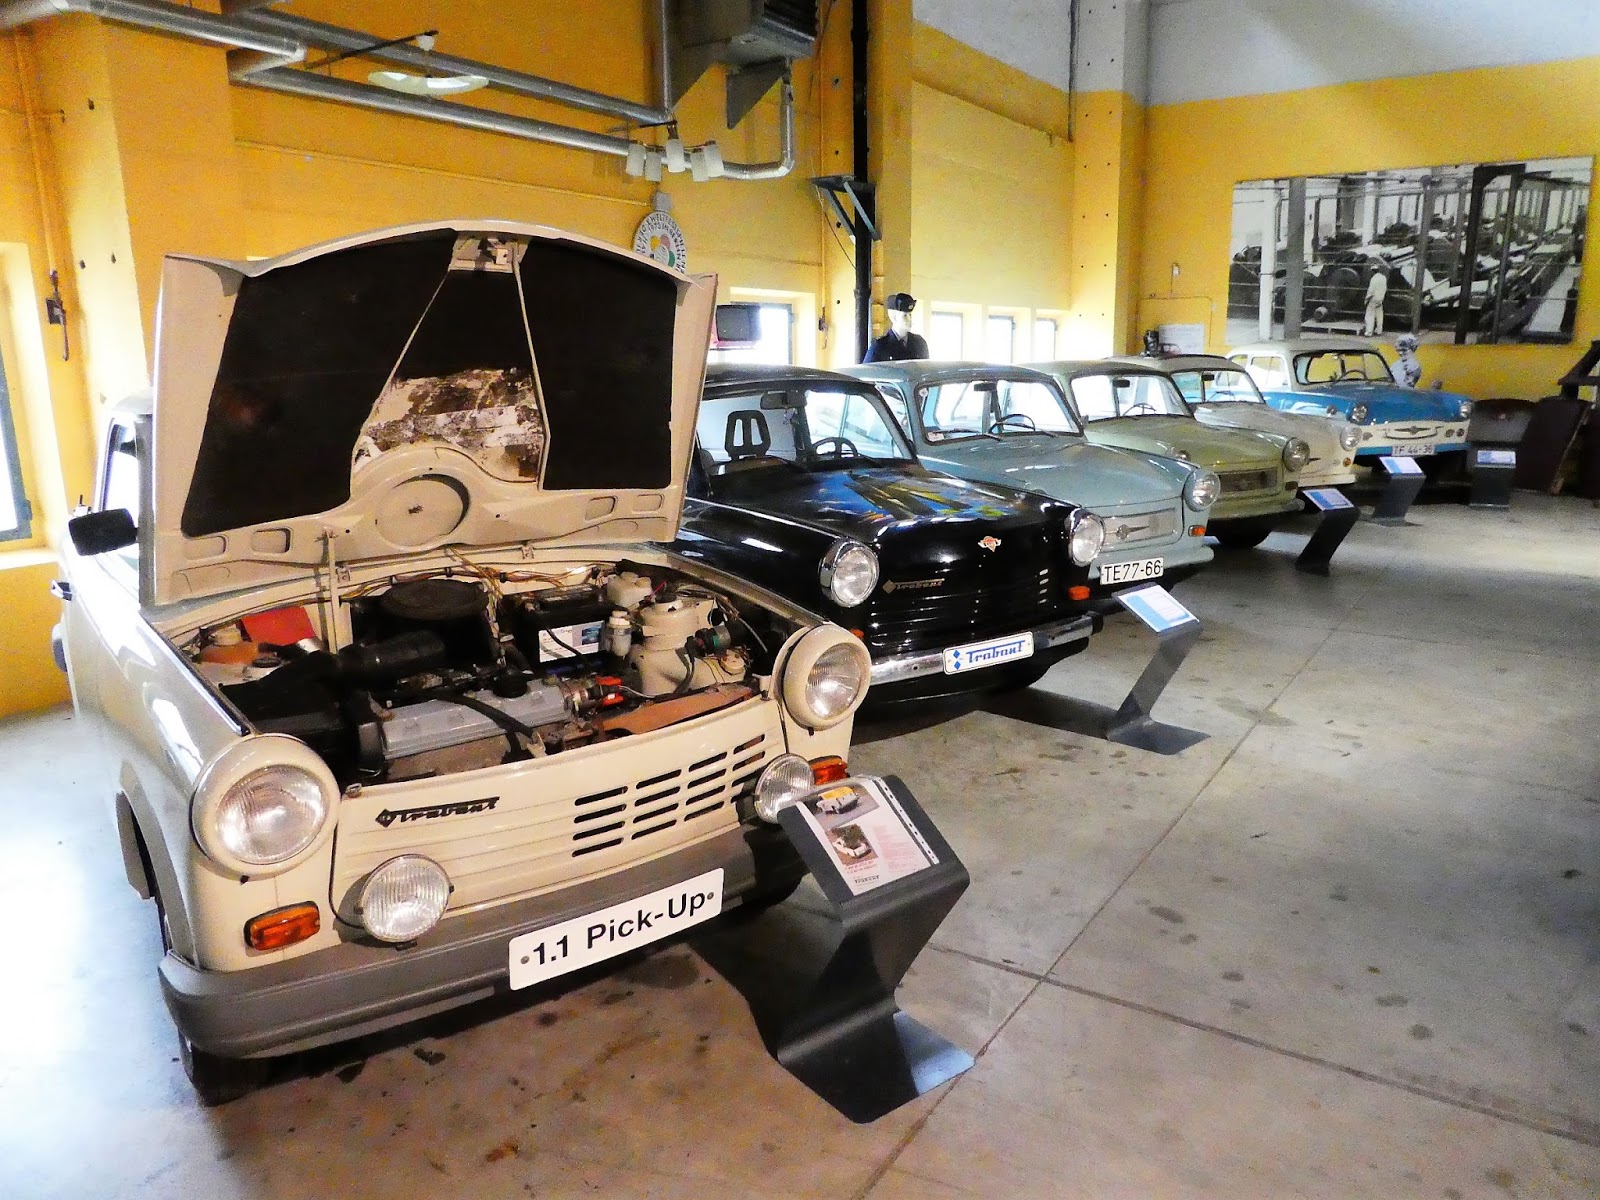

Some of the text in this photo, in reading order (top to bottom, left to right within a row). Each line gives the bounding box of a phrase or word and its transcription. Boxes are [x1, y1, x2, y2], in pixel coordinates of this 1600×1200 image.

[966, 640, 1025, 663] Trabant
[533, 892, 705, 965] 1.1 Pick-Up
